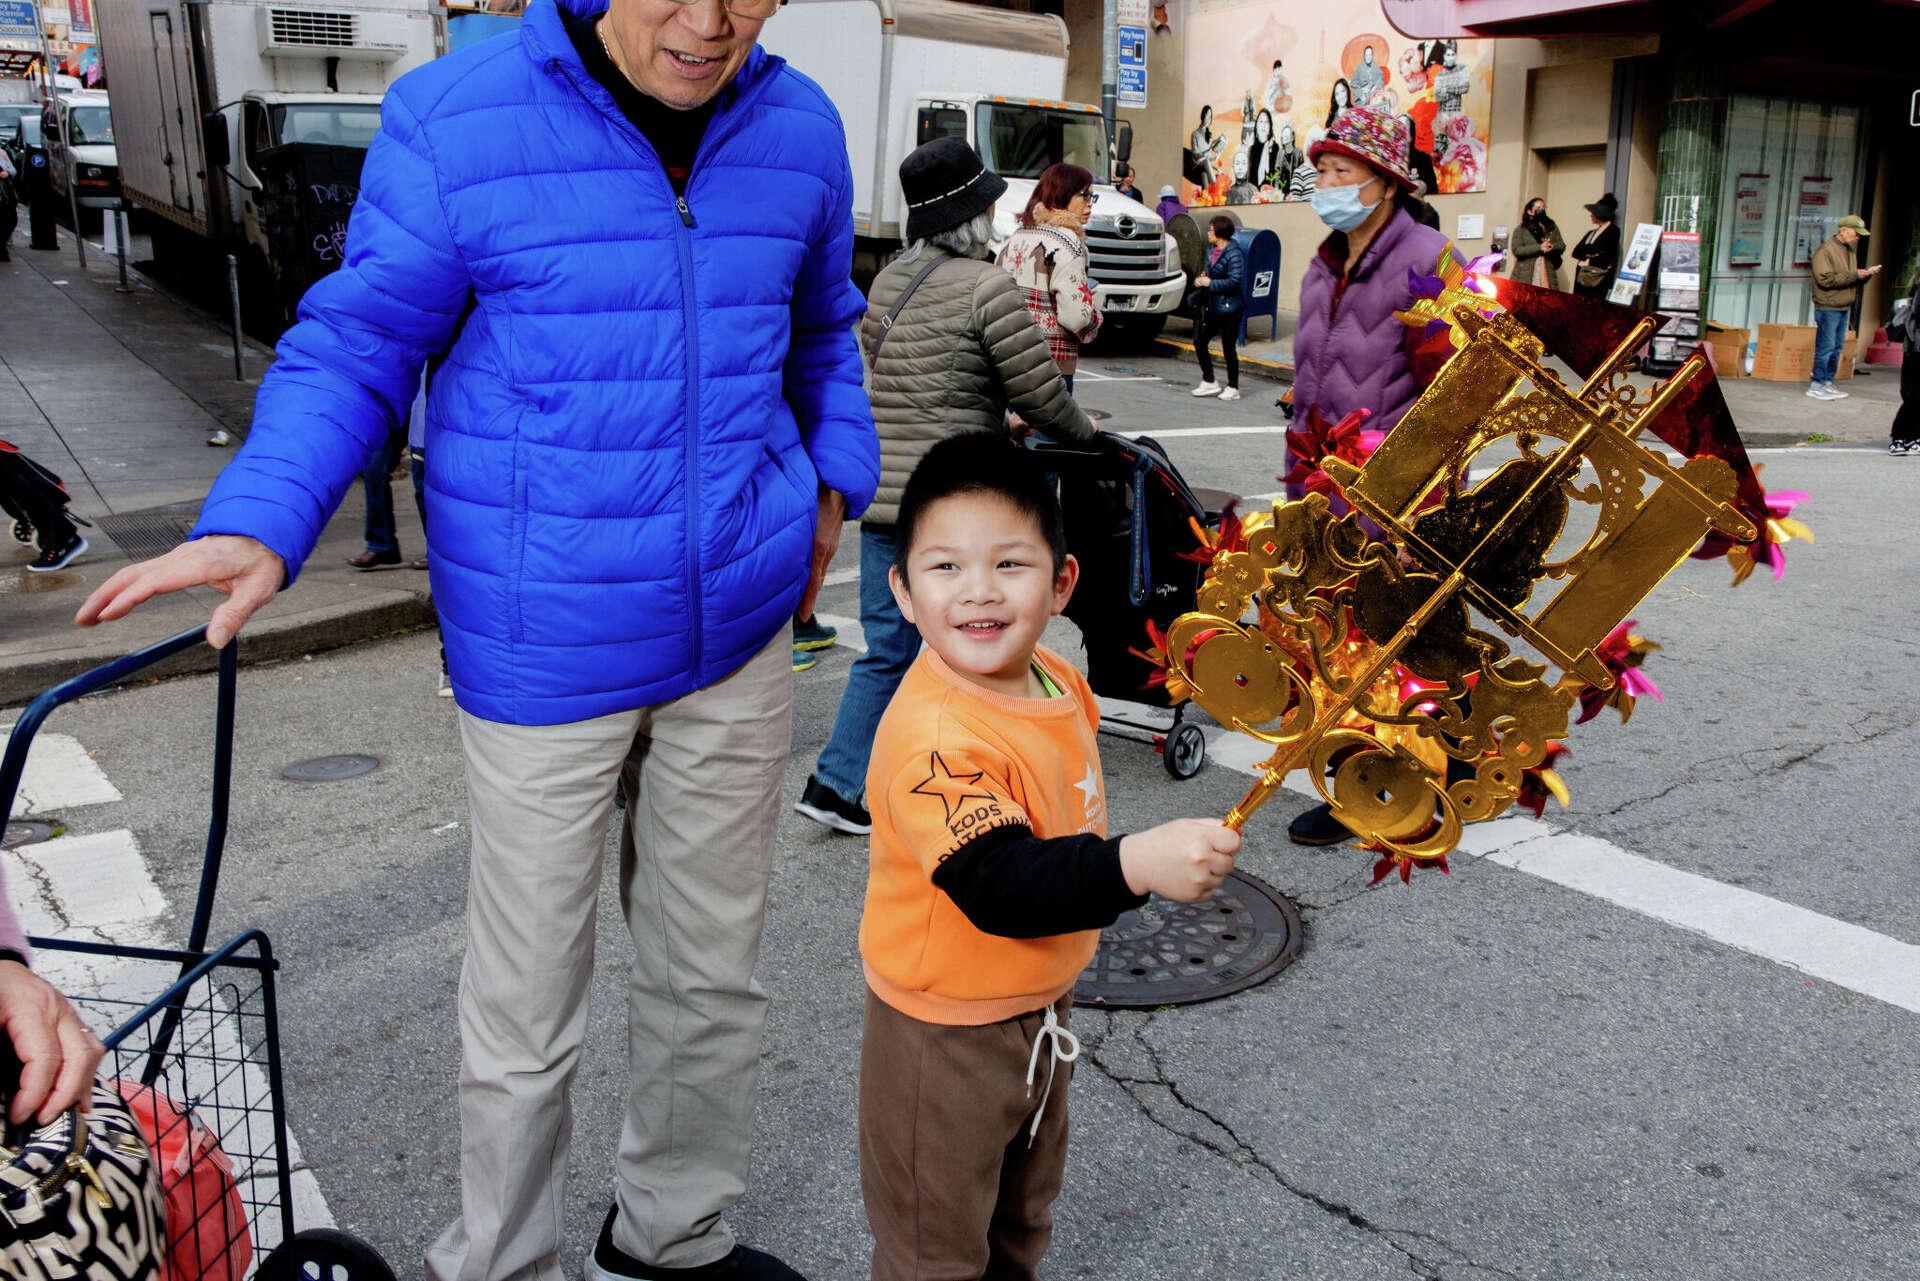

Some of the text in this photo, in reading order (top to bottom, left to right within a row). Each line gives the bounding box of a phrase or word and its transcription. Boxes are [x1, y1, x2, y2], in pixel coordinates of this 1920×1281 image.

[1120, 30, 1145, 40] Pay here
[950, 803, 1003, 838] KODS
